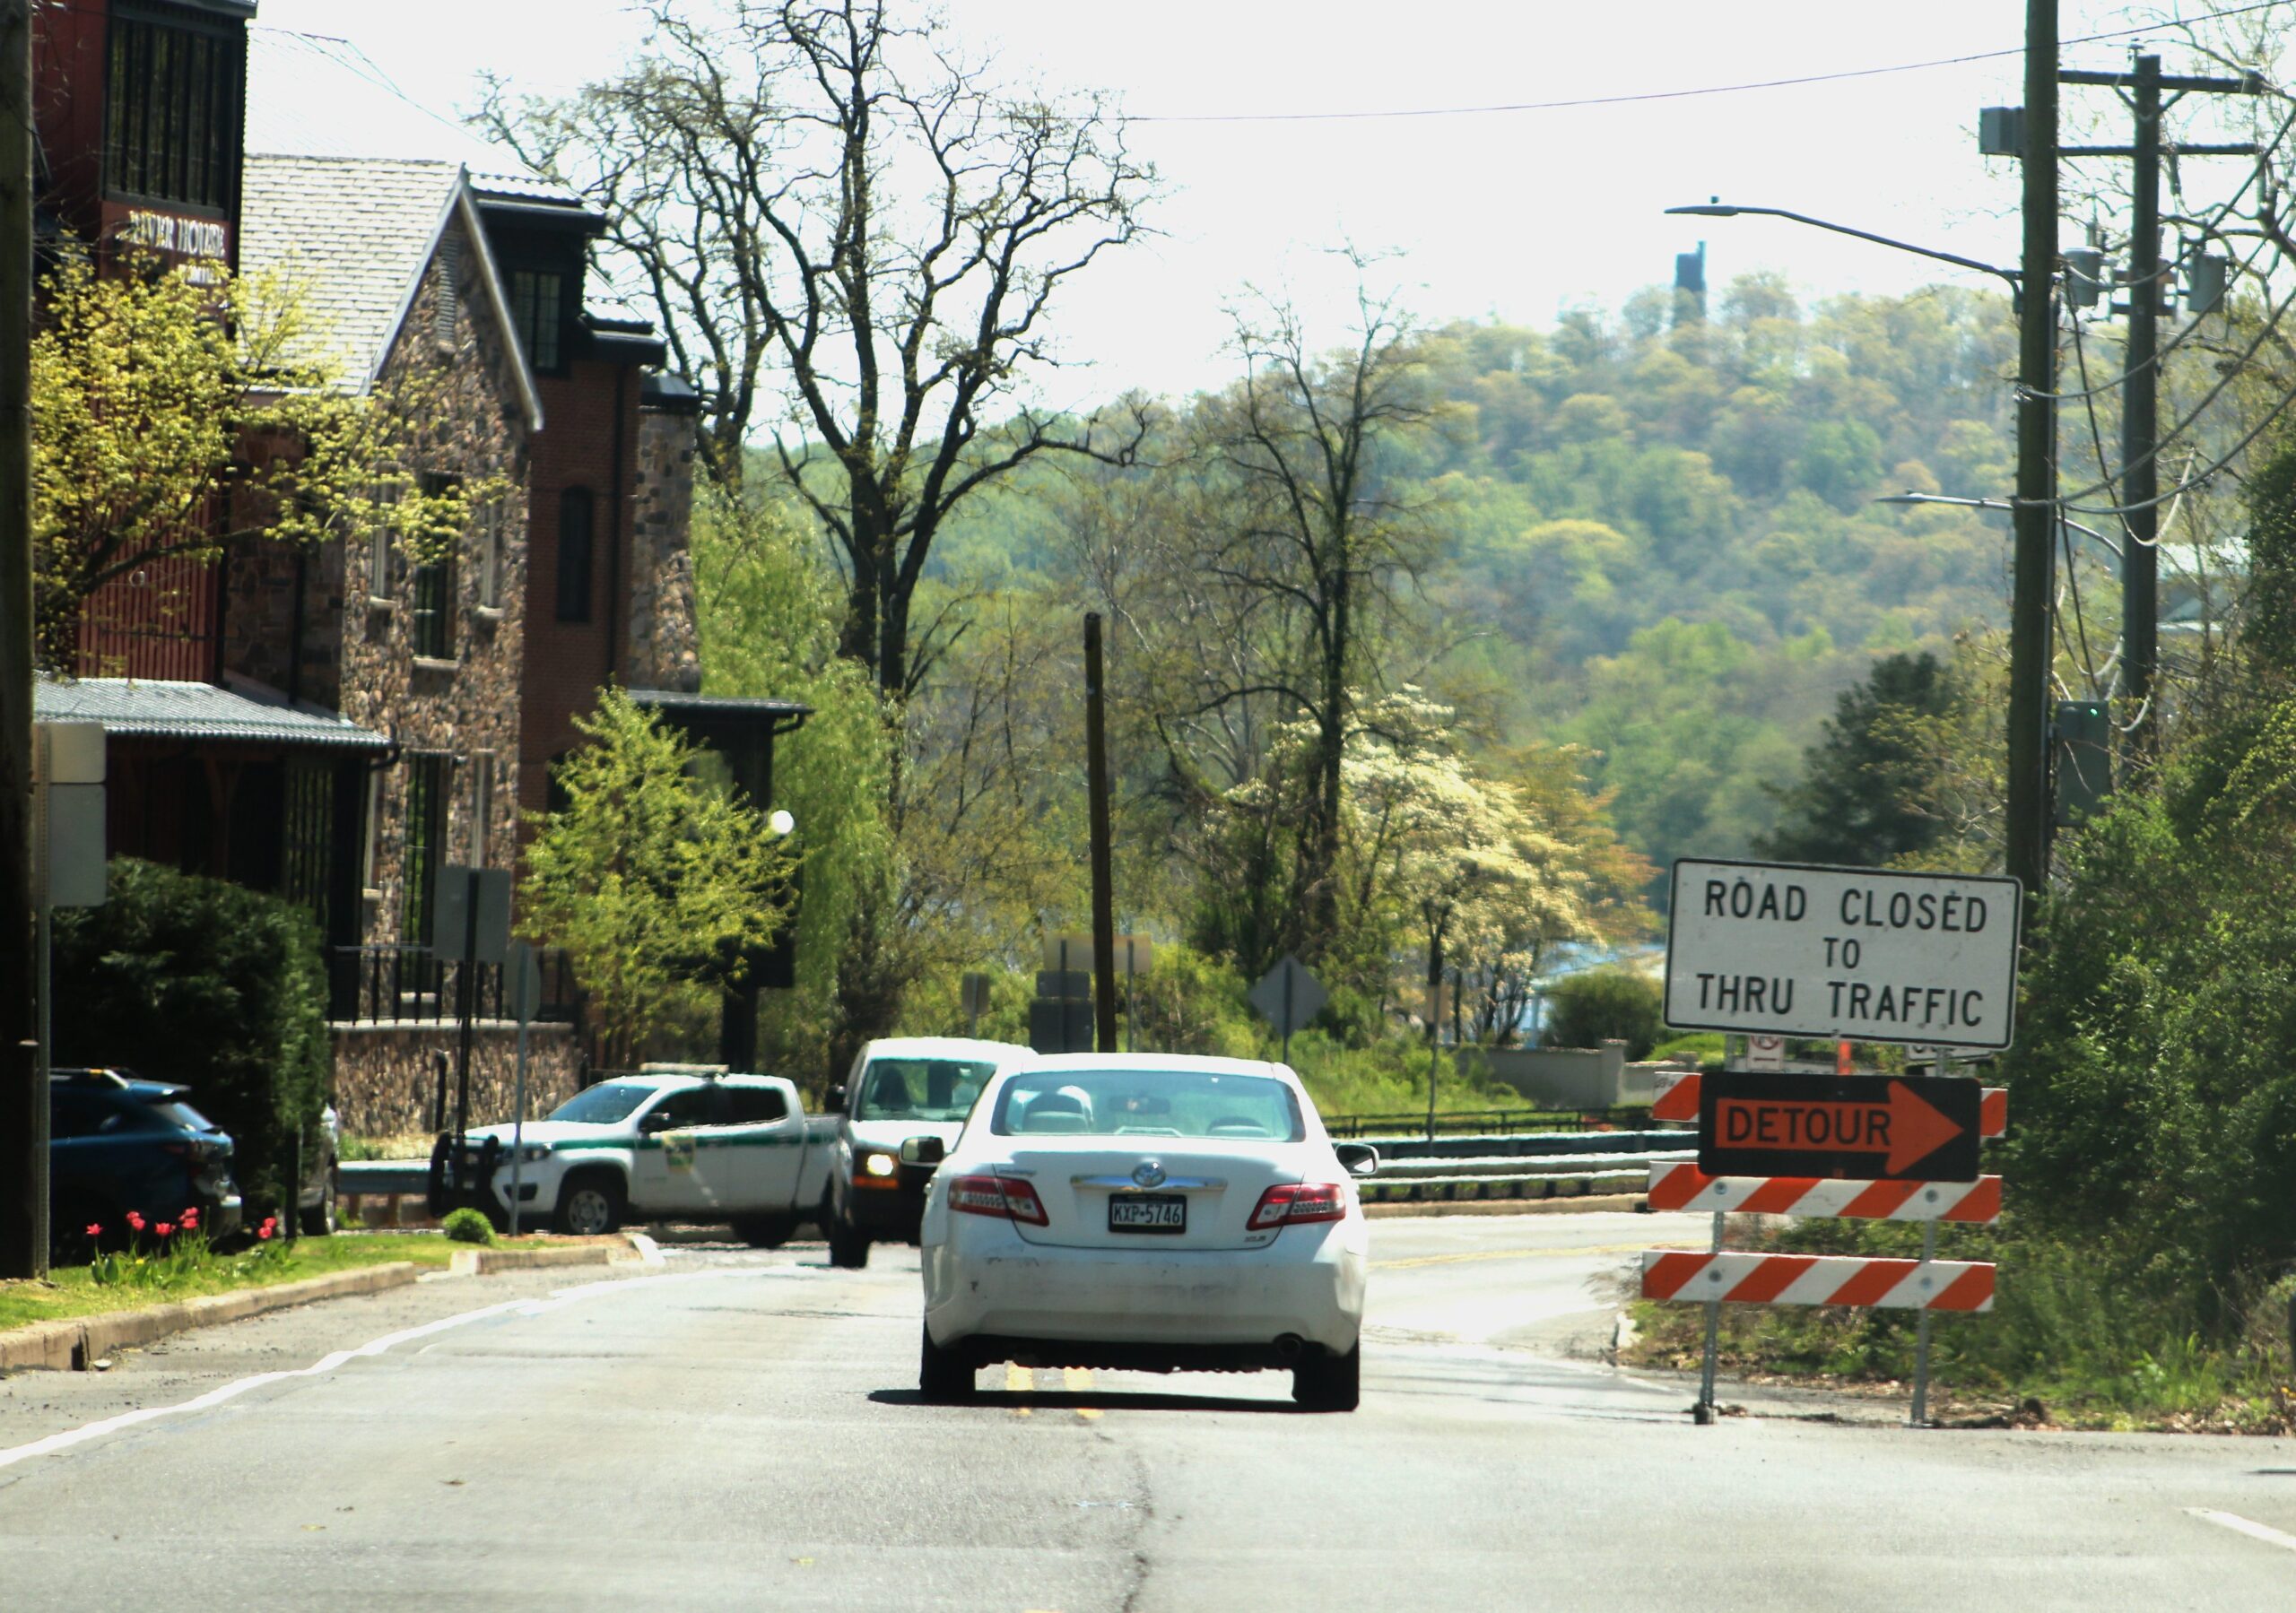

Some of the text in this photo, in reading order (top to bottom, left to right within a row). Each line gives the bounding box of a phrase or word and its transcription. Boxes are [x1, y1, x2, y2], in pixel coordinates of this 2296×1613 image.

[1705, 880, 1987, 932] ROAD CLOSED
[1822, 937, 1861, 969] TO
[1696, 973, 1984, 1027] THRU TRAFFIC
[1726, 1106, 1892, 1147] DETOUR
